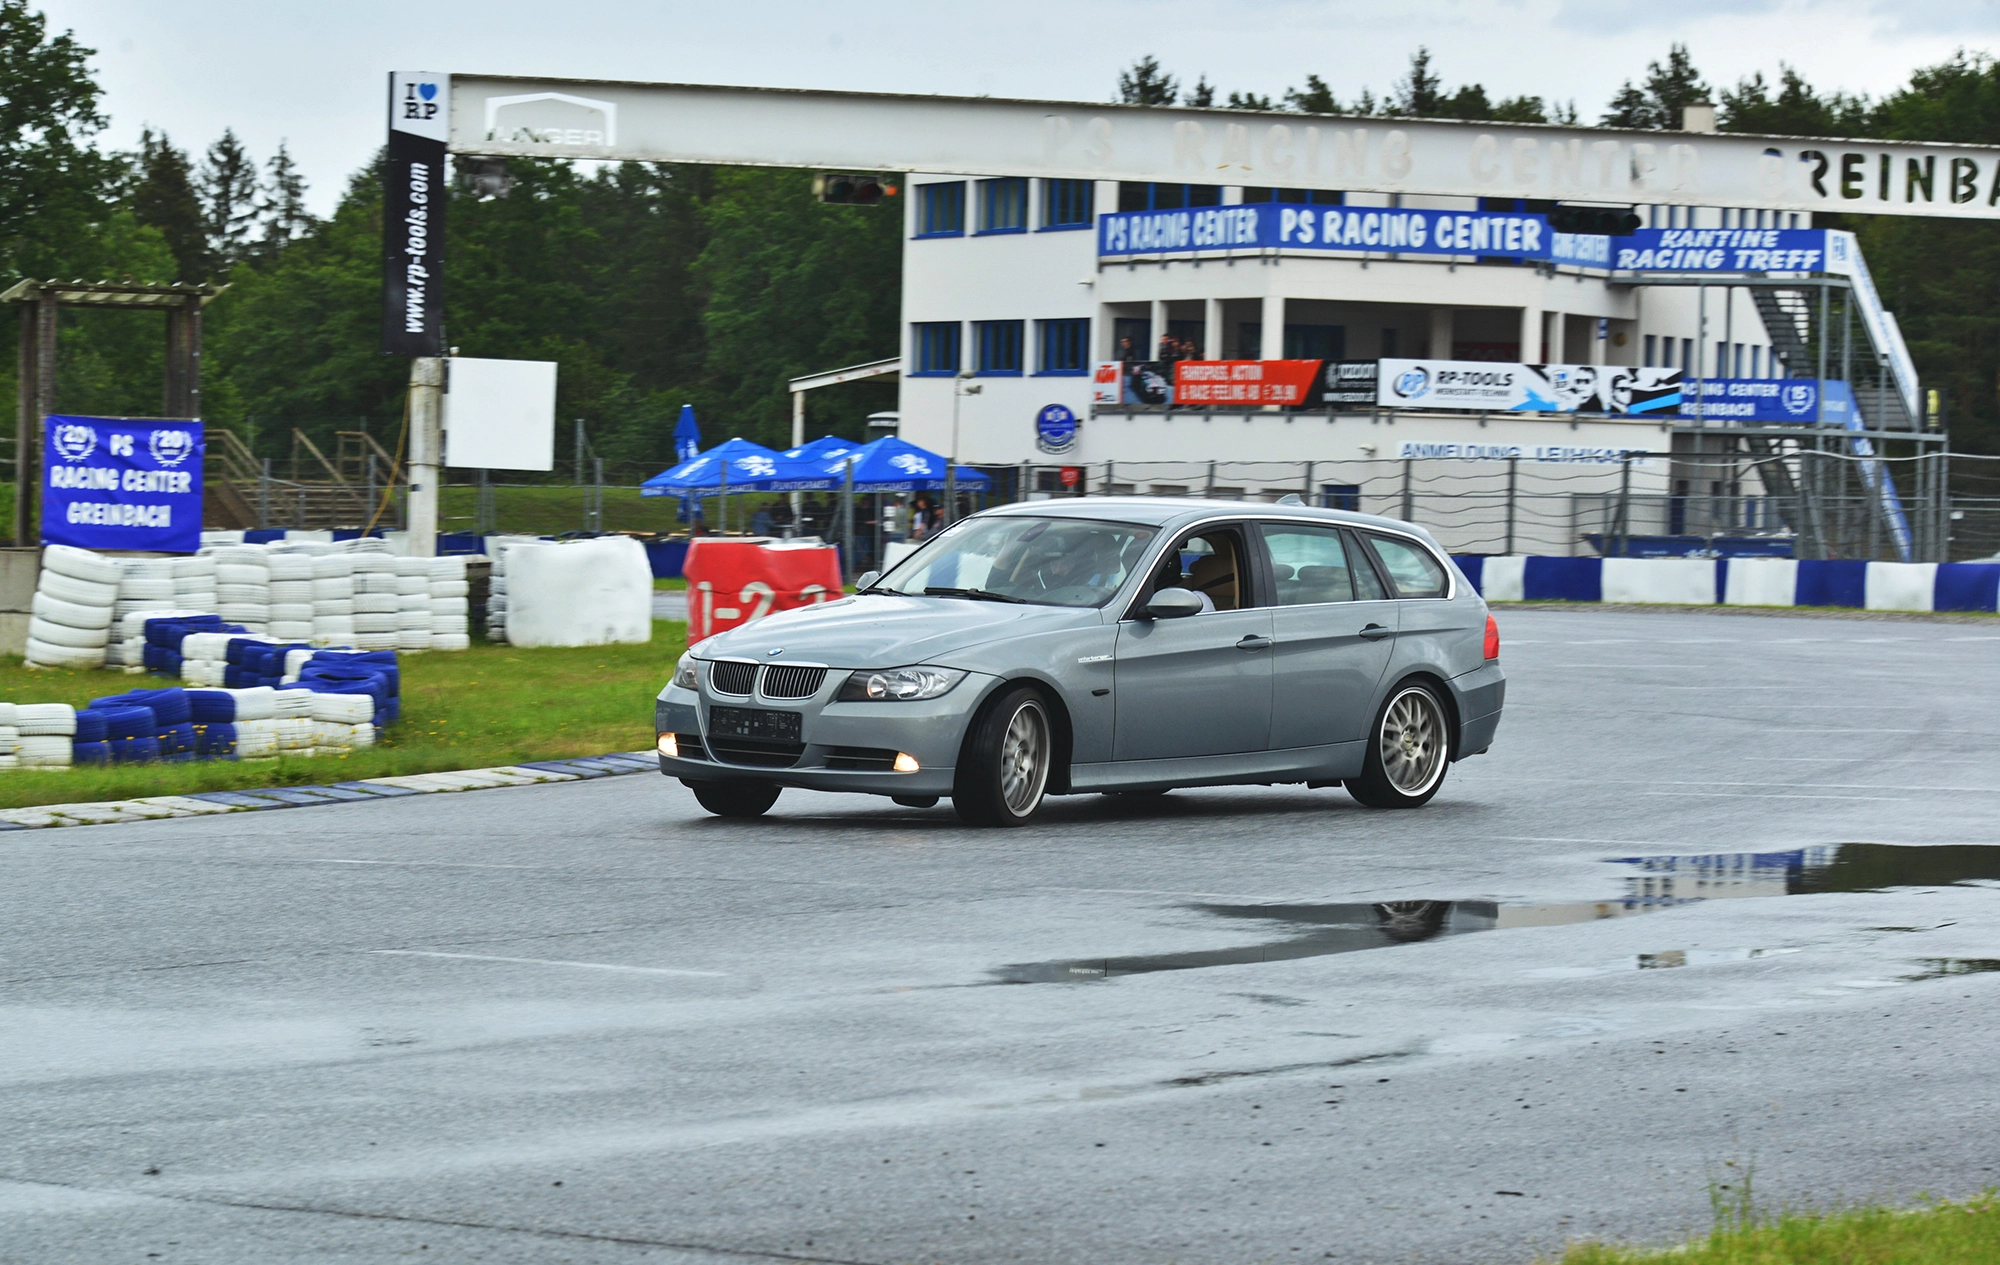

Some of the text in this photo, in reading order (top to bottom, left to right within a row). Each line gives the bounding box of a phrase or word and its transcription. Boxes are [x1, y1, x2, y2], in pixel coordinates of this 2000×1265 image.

[405, 82, 416, 100] I
[403, 101, 438, 120] RP
[1106, 208, 1258, 251] PS RACING CENTER
[1280, 208, 1542, 251] PS RACING CENTER
[1658, 229, 1781, 249] KANTINE
[404, 162, 430, 333] www.rp-tools.com
[1616, 248, 1822, 270] RACING TREFF
[1436, 370, 1514, 387] RP-TOOLS
[1727, 383, 1781, 398] CENTER
[62, 424, 89, 444] 20
[158, 429, 185, 449] 20
[110, 434, 135, 457] PS
[50, 465, 193, 494] RACING CENTER
[66, 501, 172, 528] GREINBACH
